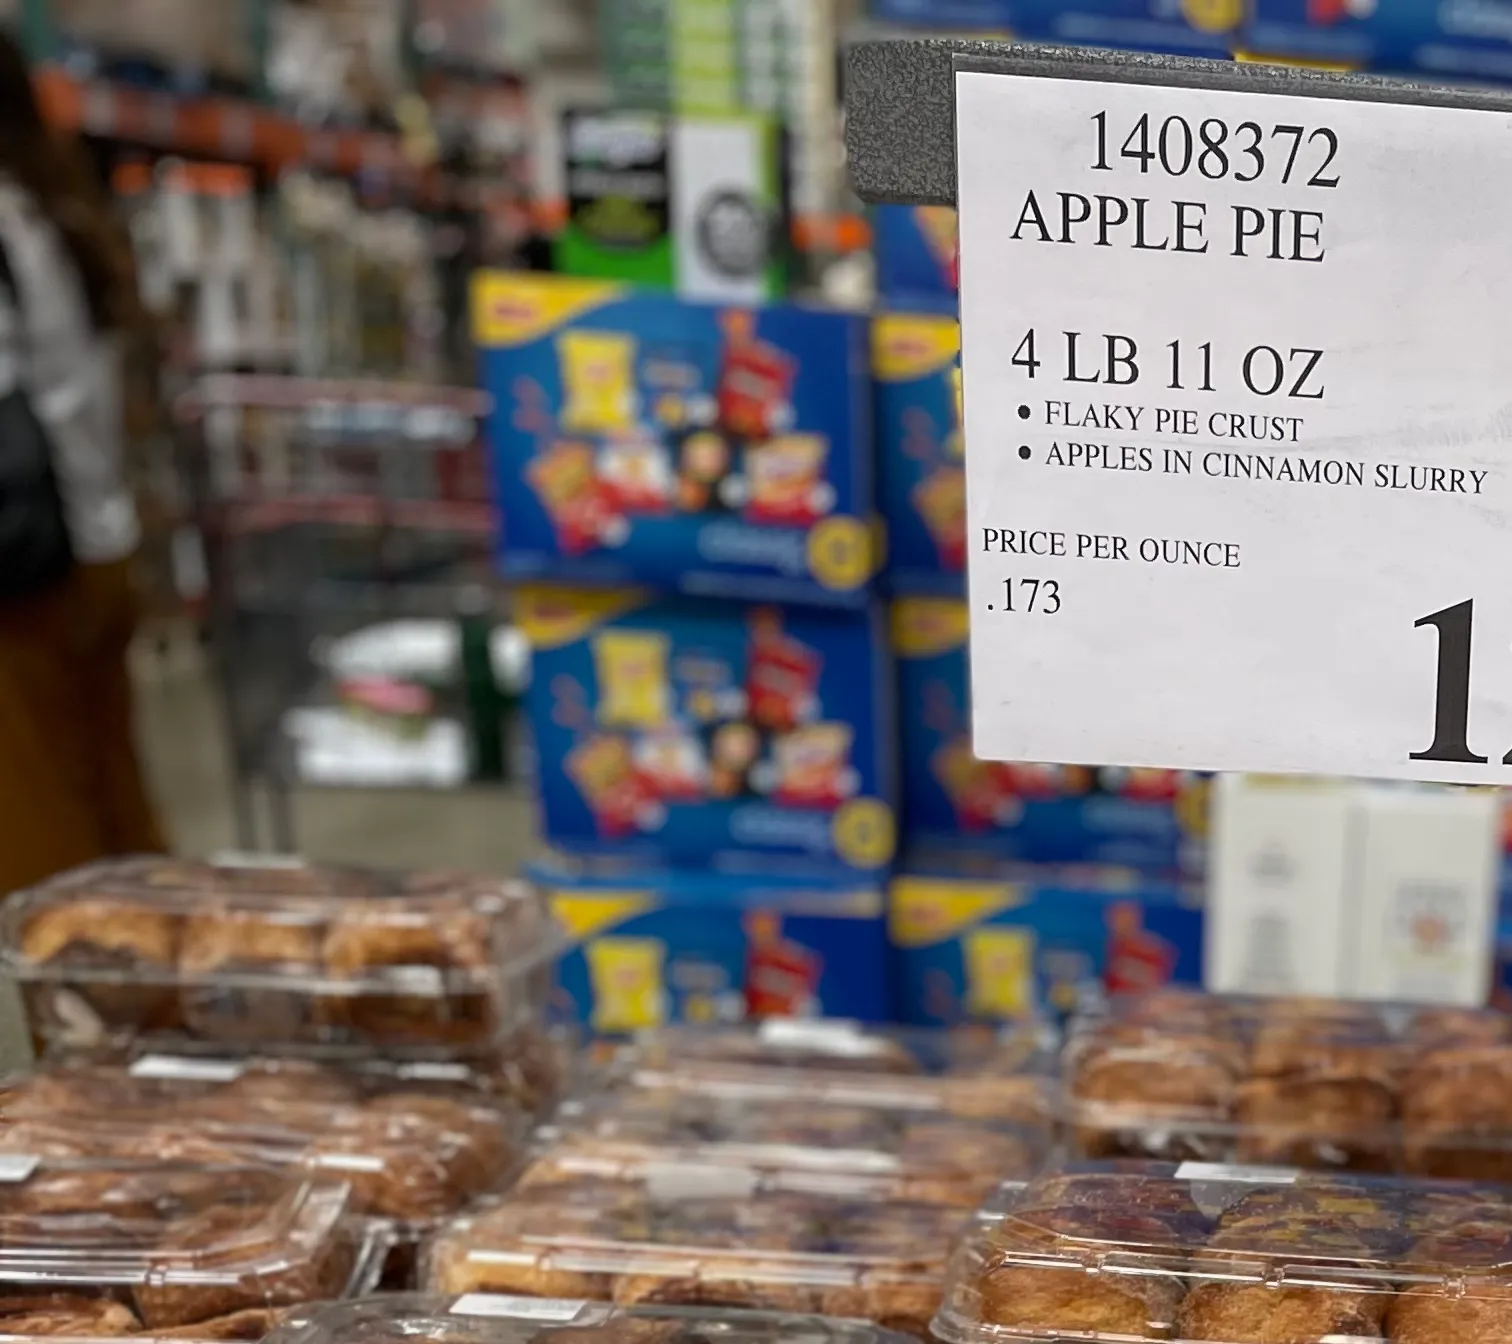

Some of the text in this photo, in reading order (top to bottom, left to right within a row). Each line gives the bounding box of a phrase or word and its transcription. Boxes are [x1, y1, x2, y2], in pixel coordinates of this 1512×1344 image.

[1091, 111, 1339, 187] 1408372
[1010, 190, 1324, 261] APPLE PIE
[1012, 329, 1324, 398] 4 LB 11 OZ
[1046, 401, 1303, 441] FLAKY PIE CRUST
[1046, 442, 1487, 493] APPLES IN CINNAMON SLURRY
[984, 529, 1240, 567] PRICE PER OUNCE
[988, 578, 1060, 613] .173
